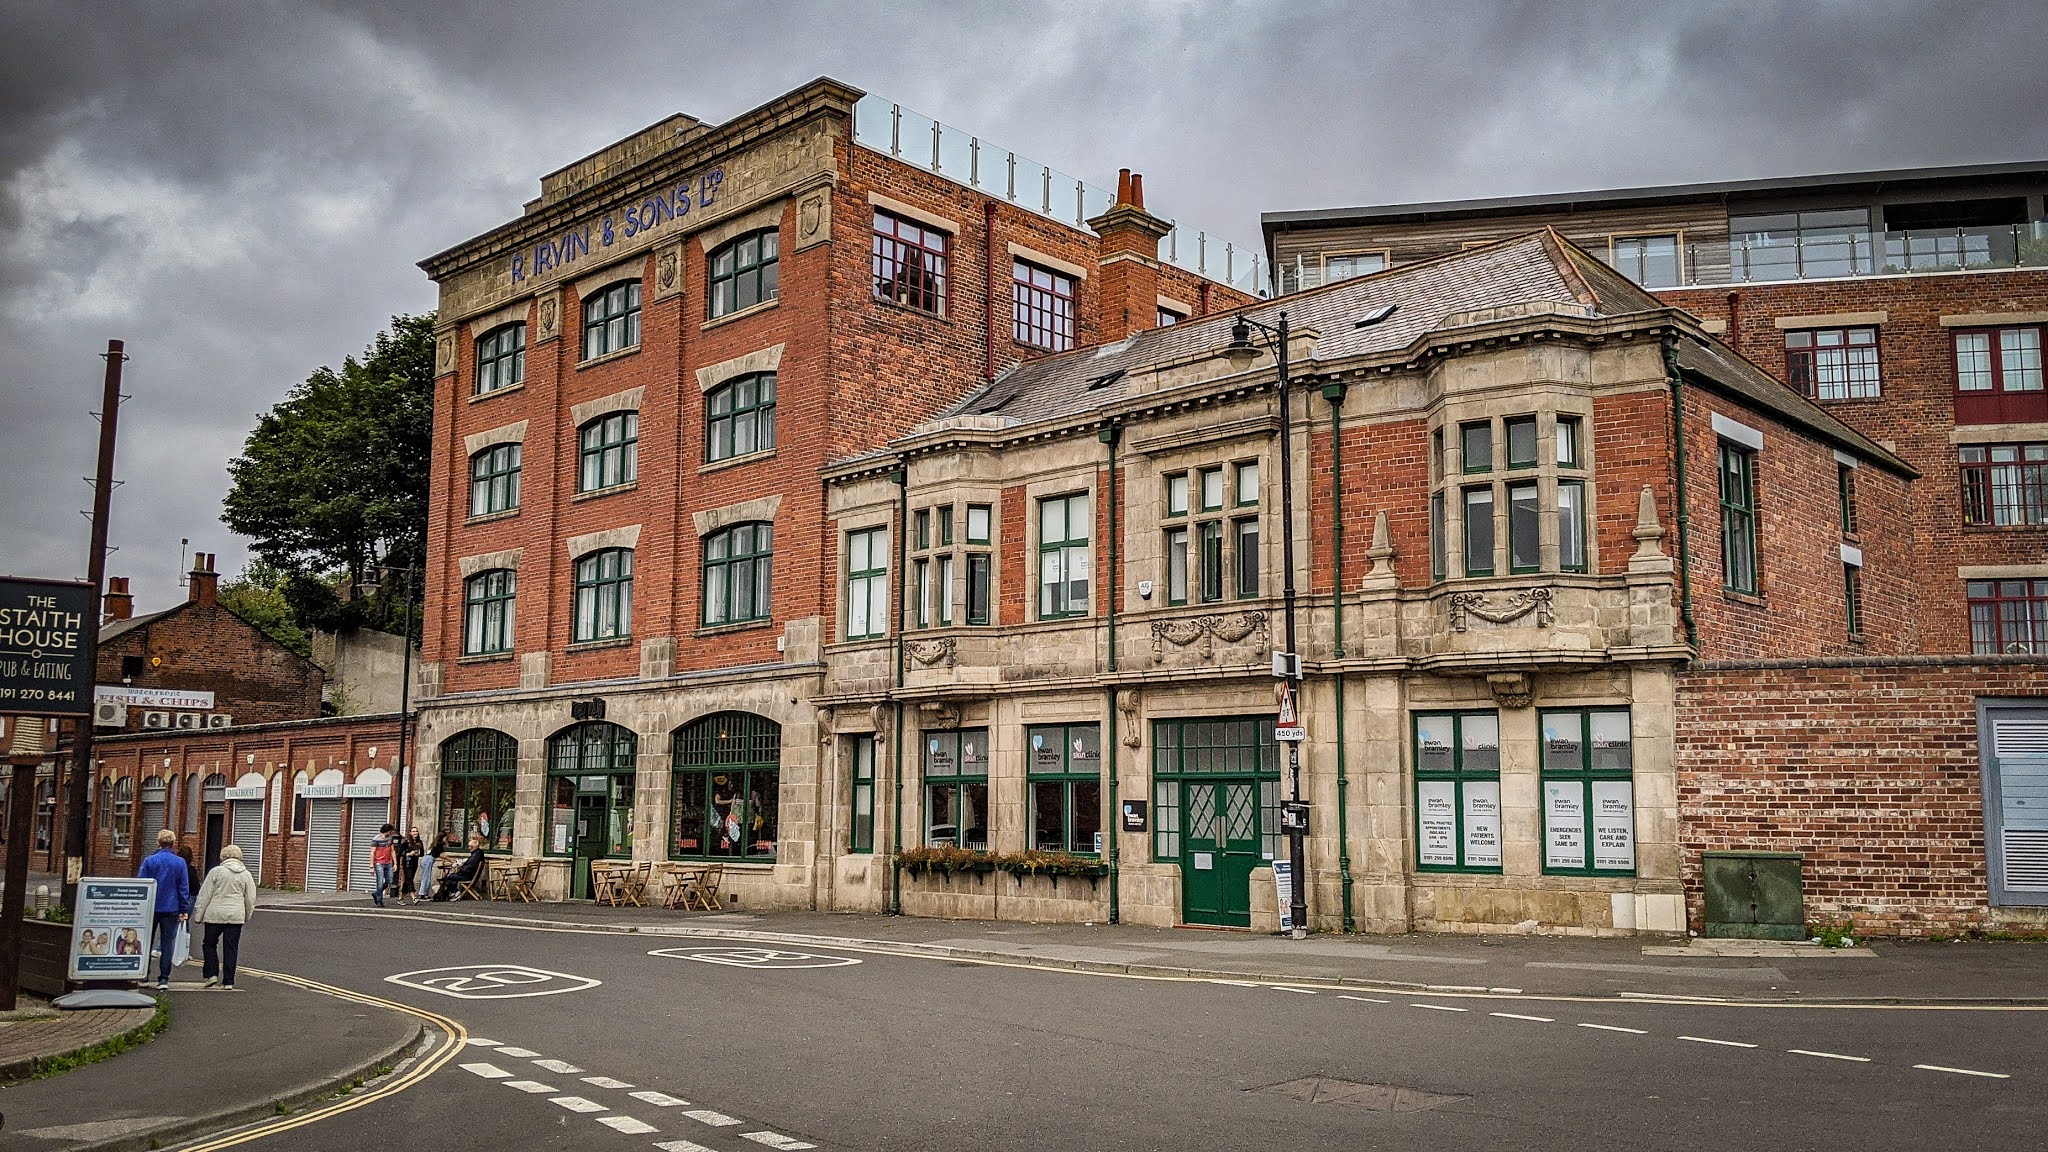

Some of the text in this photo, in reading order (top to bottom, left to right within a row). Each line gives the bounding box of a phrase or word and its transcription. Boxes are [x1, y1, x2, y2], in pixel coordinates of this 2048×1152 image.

[511, 254, 525, 284] R
[533, 226, 589, 276] IRVIN
[602, 217, 614, 246] &
[624, 184, 691, 237] SONS
[27, 595, 57, 608] THE
[0, 608, 81, 629] STAITH
[0, 628, 79, 649] HOUSE
[21, 660, 31, 676] &
[33, 662, 72, 680] EATING
[20, 689, 44, 700] 270
[48, 690, 75, 701] 8441
[159, 697, 209, 707] CHIPS
[1292, 729, 1303, 738] yds
[1550, 743, 1579, 751] bramley
[1037, 753, 1060, 762] bramley
[347, 786, 377, 796] FRESH FISH
[422, 970, 553, 992] 20
